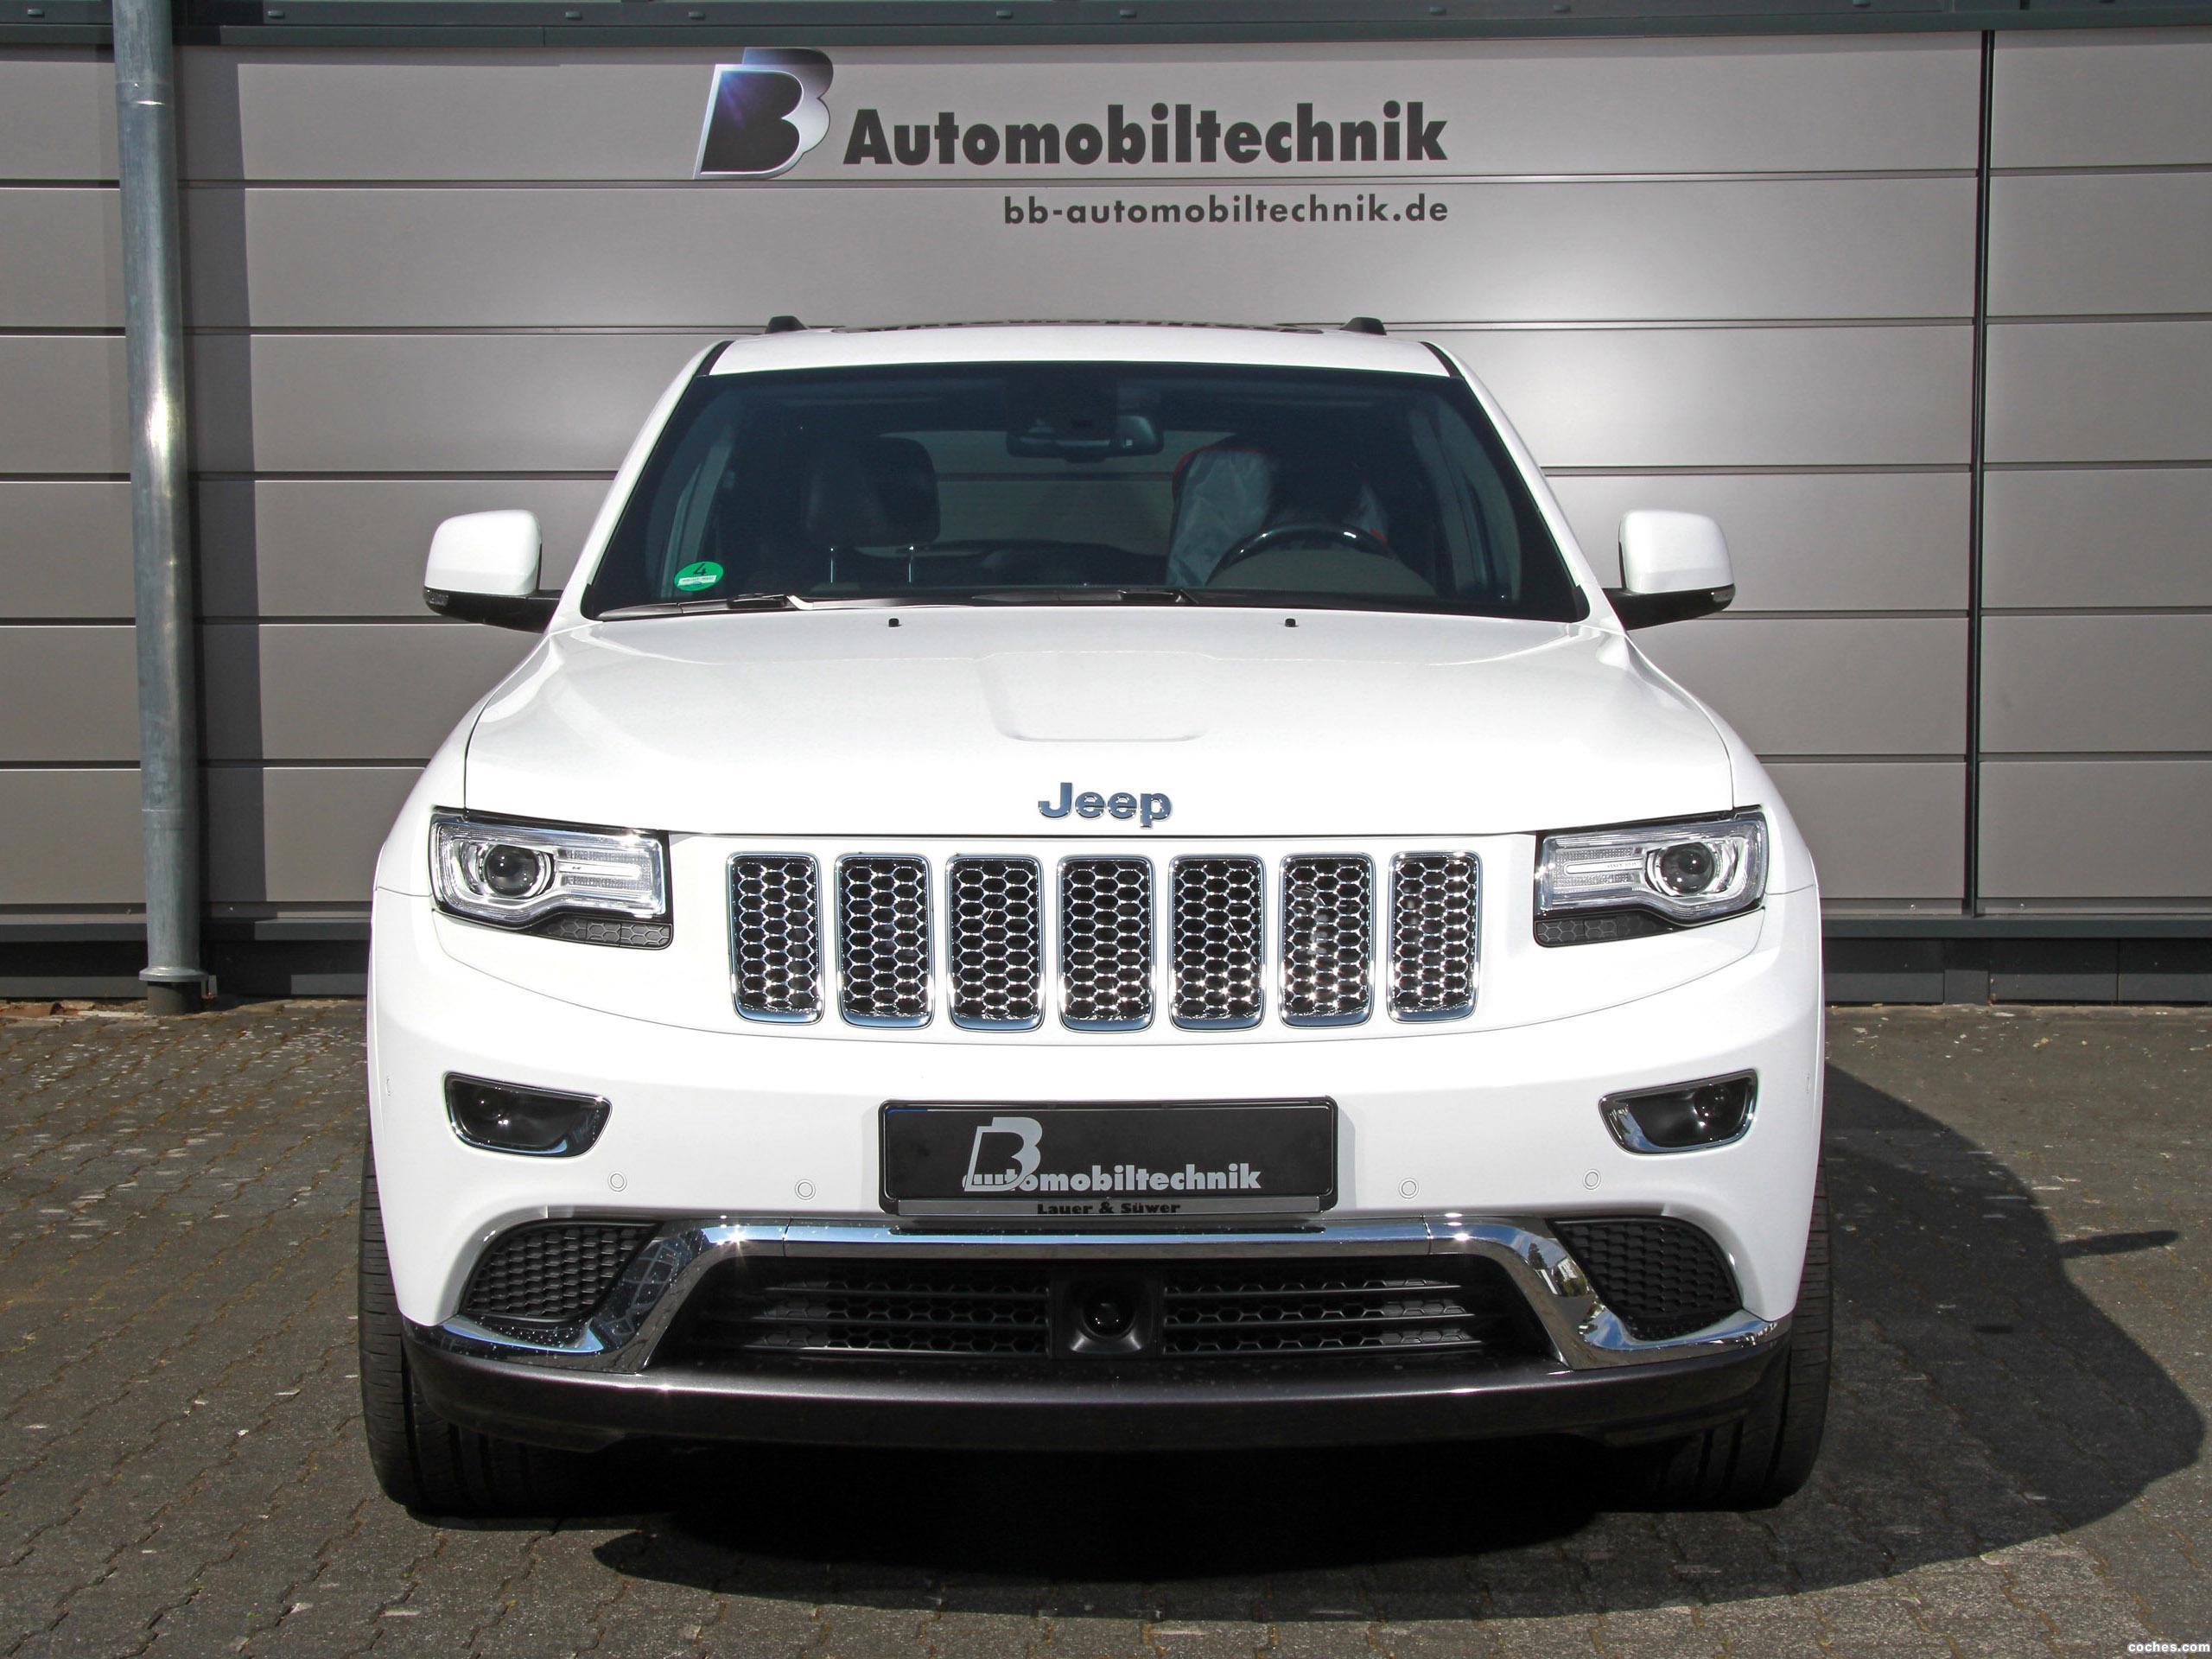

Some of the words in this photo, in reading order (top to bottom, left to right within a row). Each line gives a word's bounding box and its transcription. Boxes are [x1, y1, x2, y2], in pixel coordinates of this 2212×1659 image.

[843, 101, 1449, 166] Automobiltechnik
[1003, 193, 1449, 225] bb-automobiltechnik.de
[693, 563, 707, 576] 4
[1038, 781, 1172, 829] Jeep
[1037, 1203, 1093, 1215] Lauer
[1098, 1201, 1115, 1215] &
[1121, 1202, 1181, 1215] Süwer
